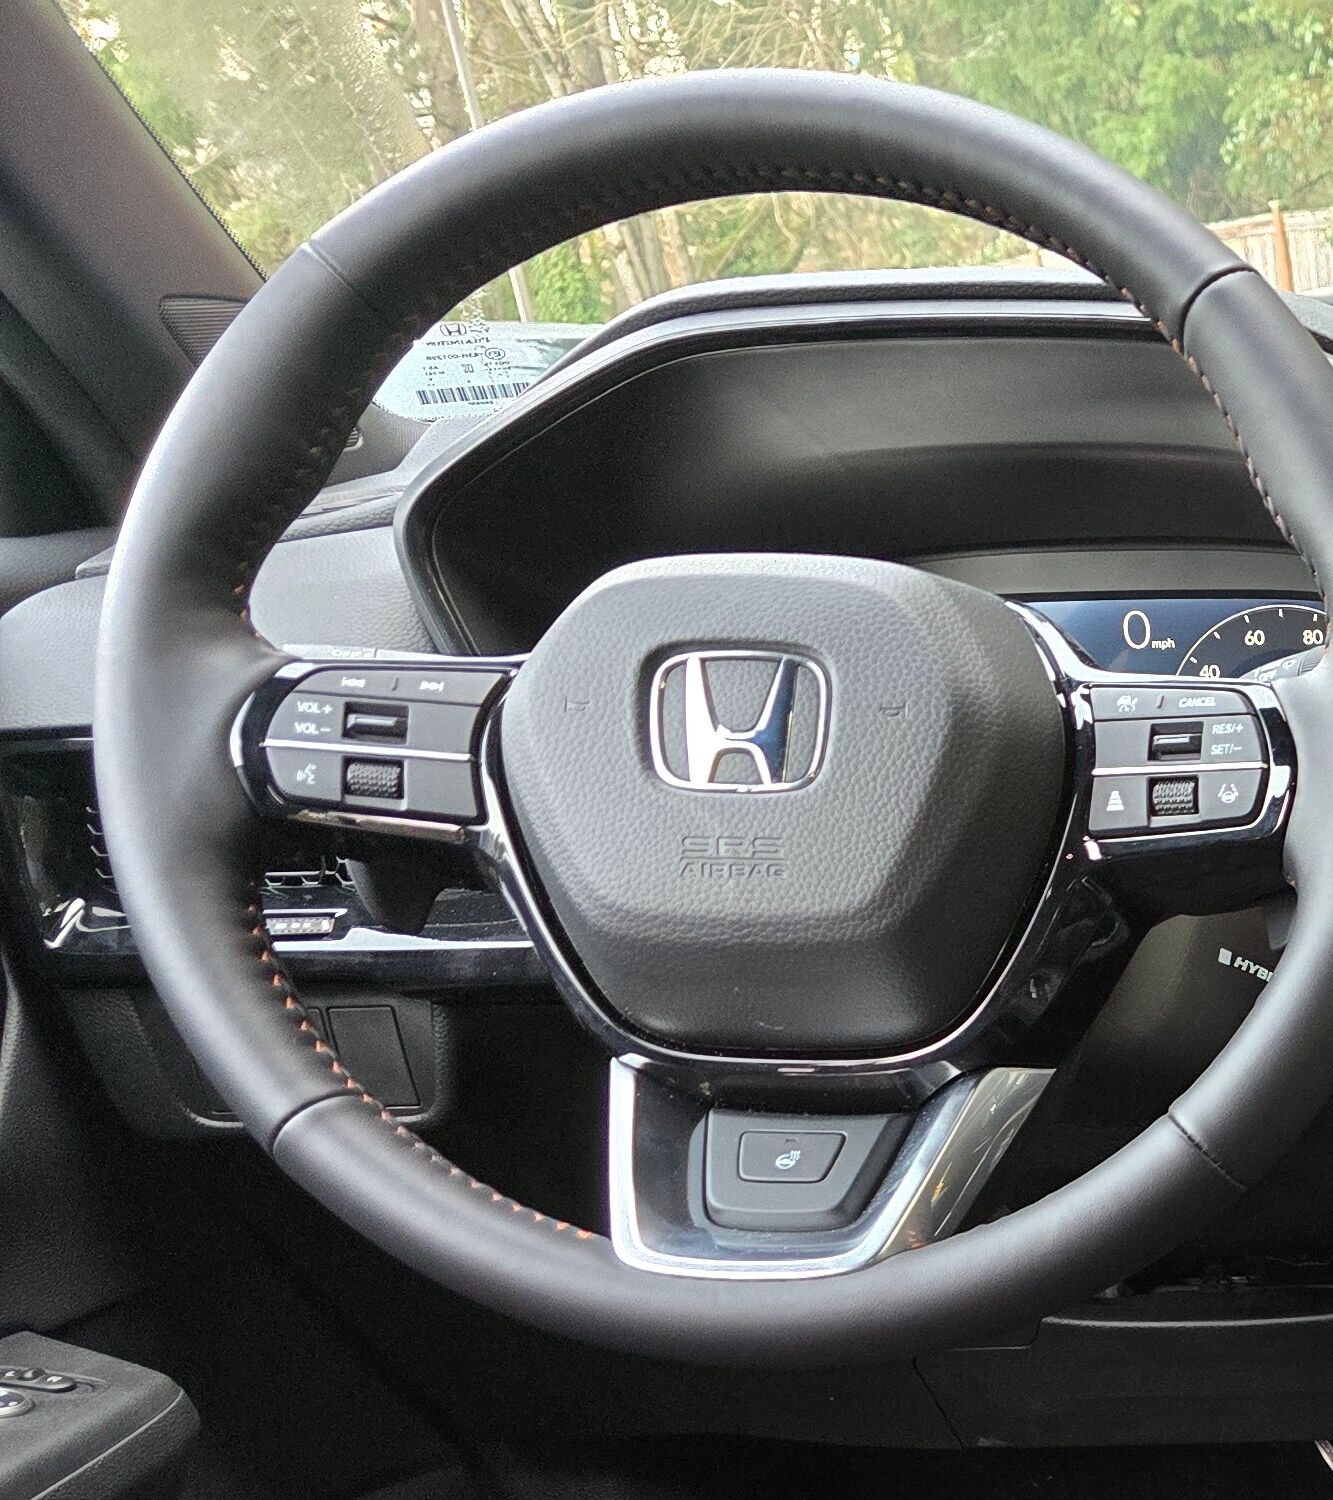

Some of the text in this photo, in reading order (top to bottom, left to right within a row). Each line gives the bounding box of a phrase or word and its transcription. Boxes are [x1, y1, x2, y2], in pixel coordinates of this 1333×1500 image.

[1123, 610, 1176, 651] 0 mph
[1244, 630, 1266, 646] 60
[1302, 629, 1324, 645] 80
[1199, 664, 1221, 678] 40
[1178, 696, 1217, 708] CANCEL
[681, 836, 785, 854] SRS
[680, 862, 786, 878] AIRBAG
